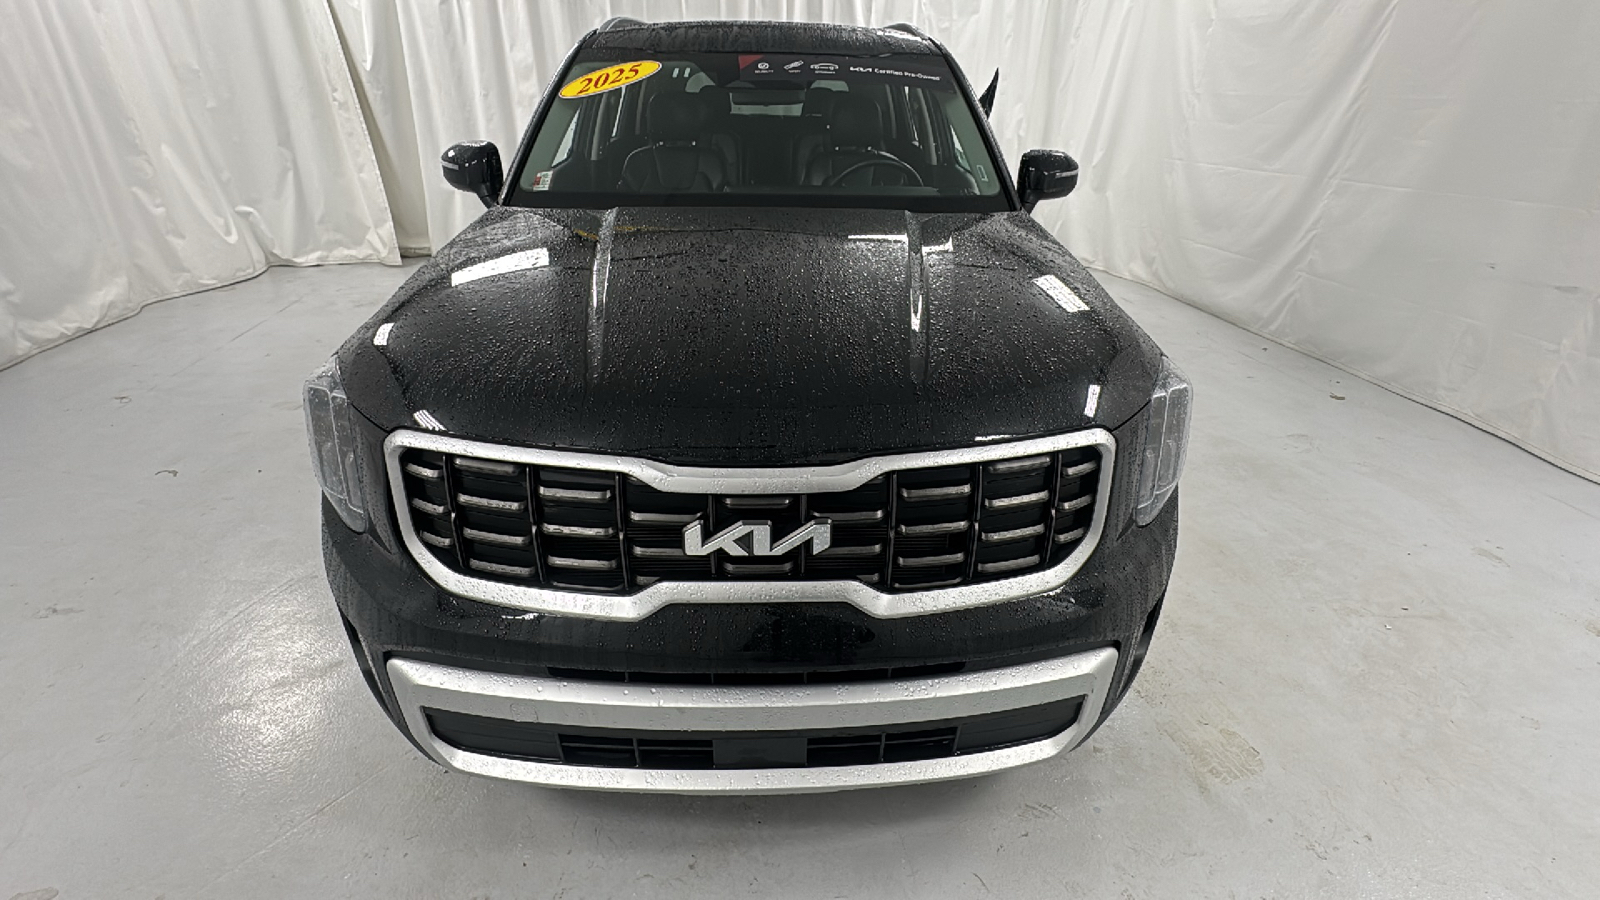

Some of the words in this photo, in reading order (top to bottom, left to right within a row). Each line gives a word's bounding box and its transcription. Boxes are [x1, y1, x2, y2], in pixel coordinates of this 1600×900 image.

[576, 63, 642, 95] 2025
[874, 68, 903, 76] Certified
[904, 71, 941, 81] Pre-Owned
[683, 519, 833, 556] KIA
